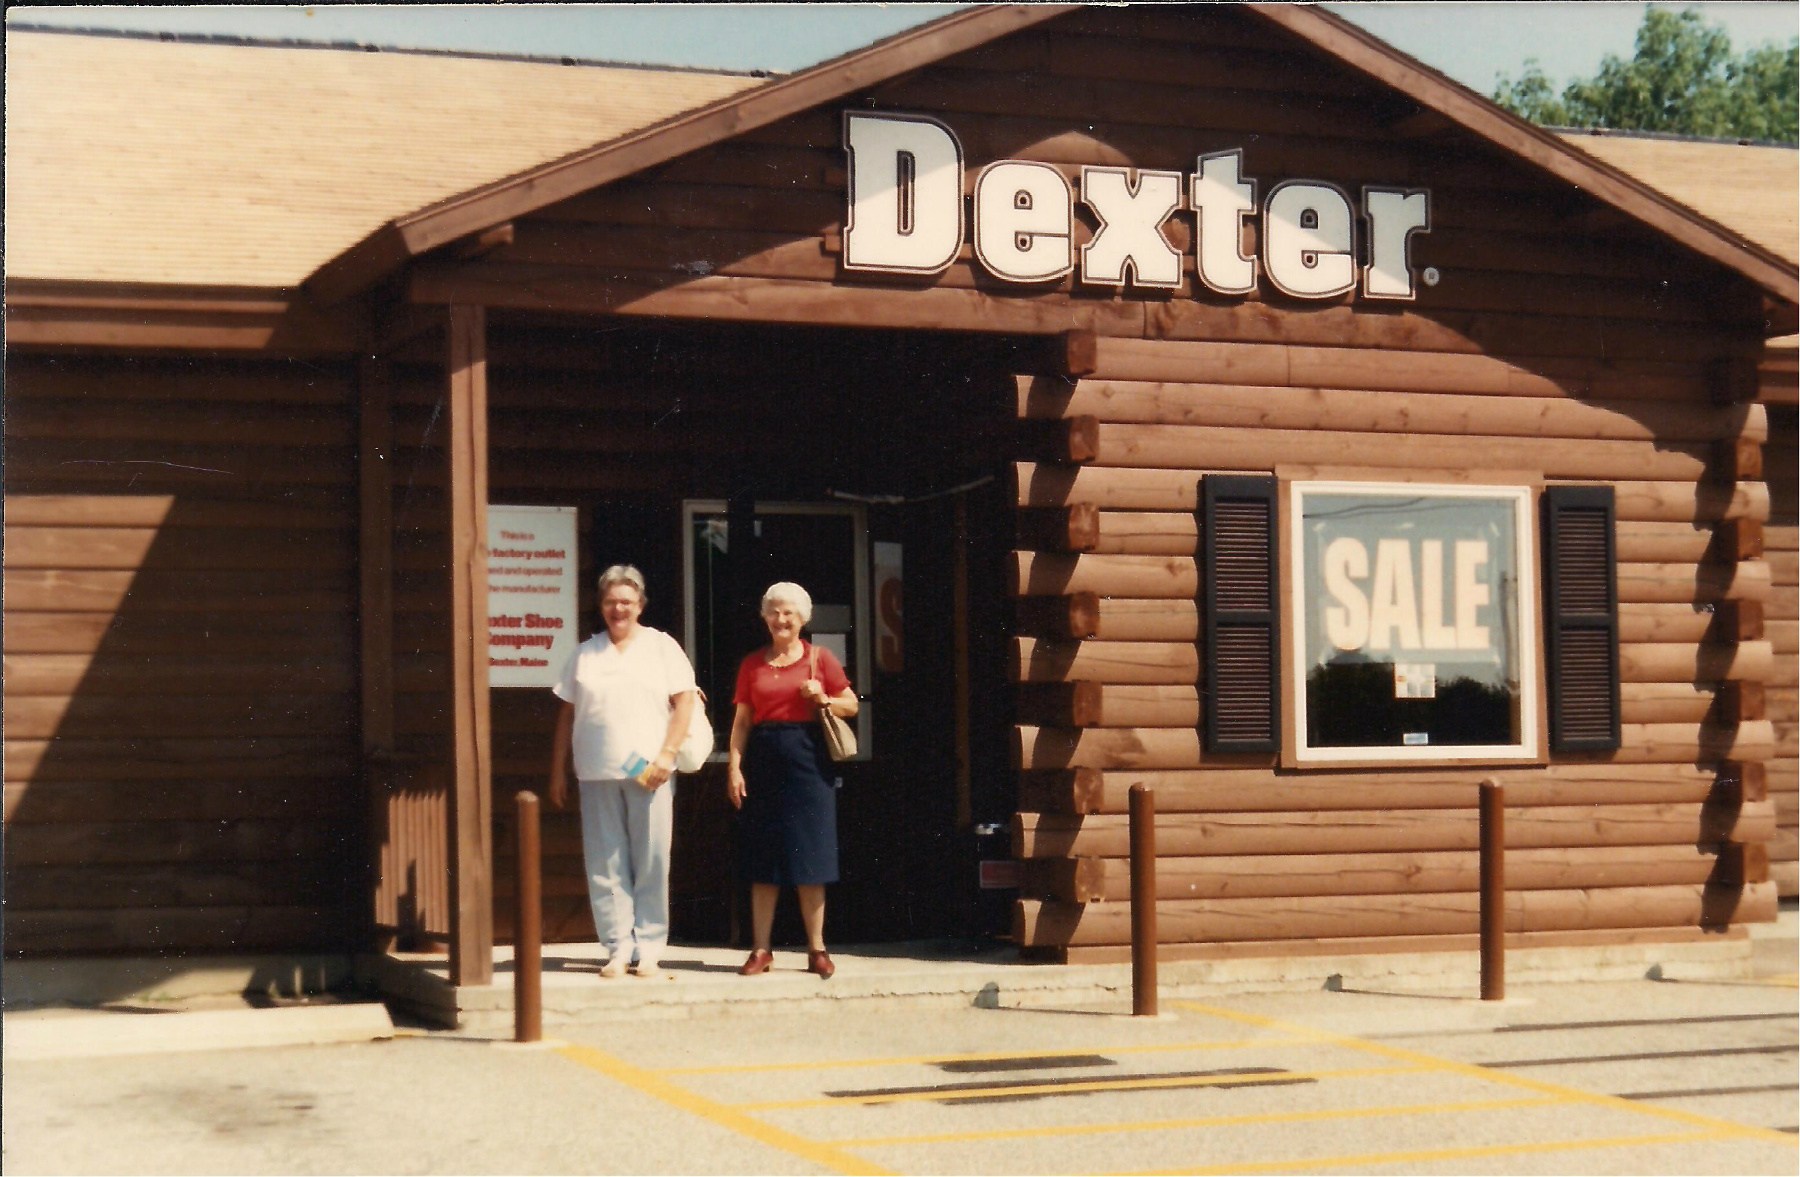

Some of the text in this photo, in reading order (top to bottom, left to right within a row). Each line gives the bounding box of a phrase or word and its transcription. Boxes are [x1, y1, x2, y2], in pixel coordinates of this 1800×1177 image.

[843, 110, 1431, 300] Dexter
[492, 548, 533, 560] factory
[534, 549, 566, 559] outlet
[504, 567, 521, 575] and
[523, 567, 563, 578] operated
[502, 585, 561, 593] manufacturer
[1324, 536, 1490, 651] SALE
[488, 613, 564, 629] exter Shoe
[520, 657, 549, 667] Maine
